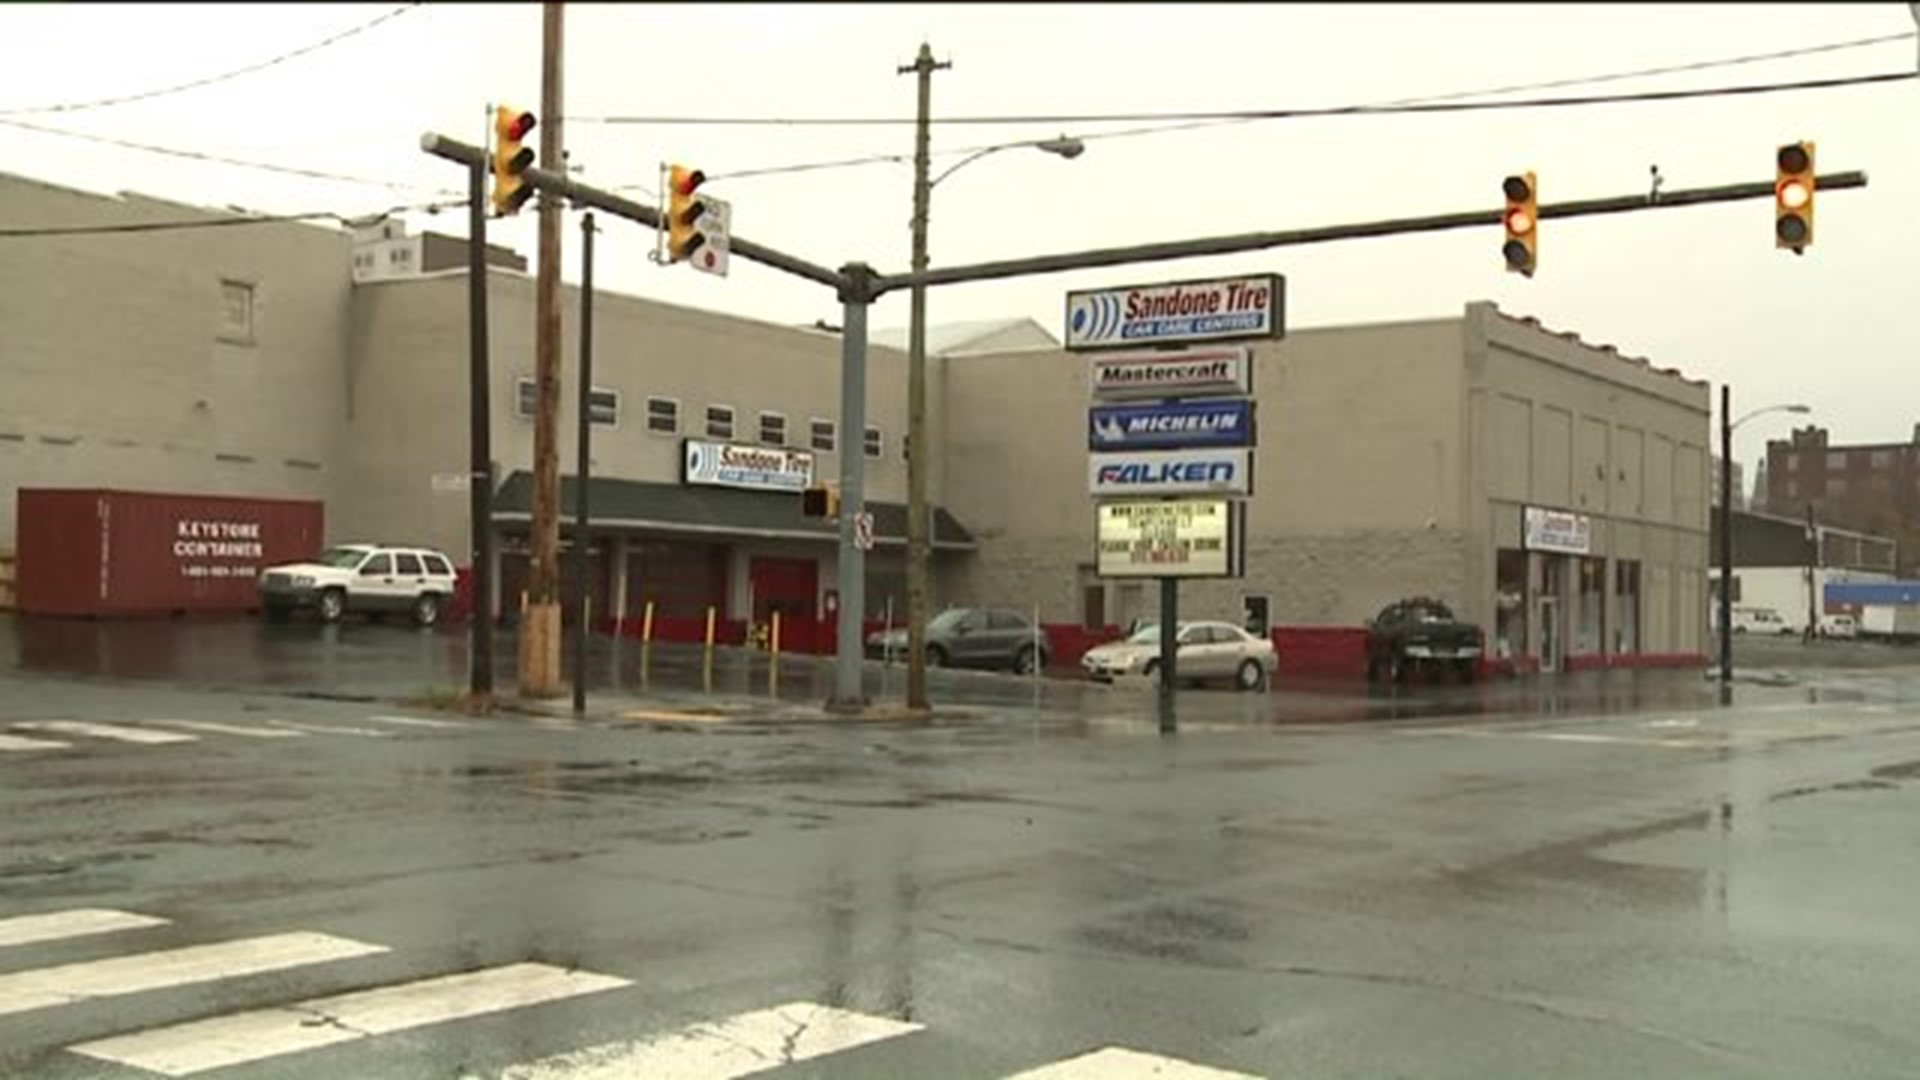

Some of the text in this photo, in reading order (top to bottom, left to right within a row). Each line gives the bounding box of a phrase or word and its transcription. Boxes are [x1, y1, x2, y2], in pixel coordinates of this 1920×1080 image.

[1125, 284, 1268, 320] Sandone Tire
[1102, 362, 1229, 382] Mastercraft
[1128, 413, 1239, 432] MICHELIN
[720, 446, 782, 472] Sandone
[1098, 462, 1235, 484] FALKEN
[178, 520, 260, 538] KEYSTONE
[173, 541, 263, 557] CONTAINER
